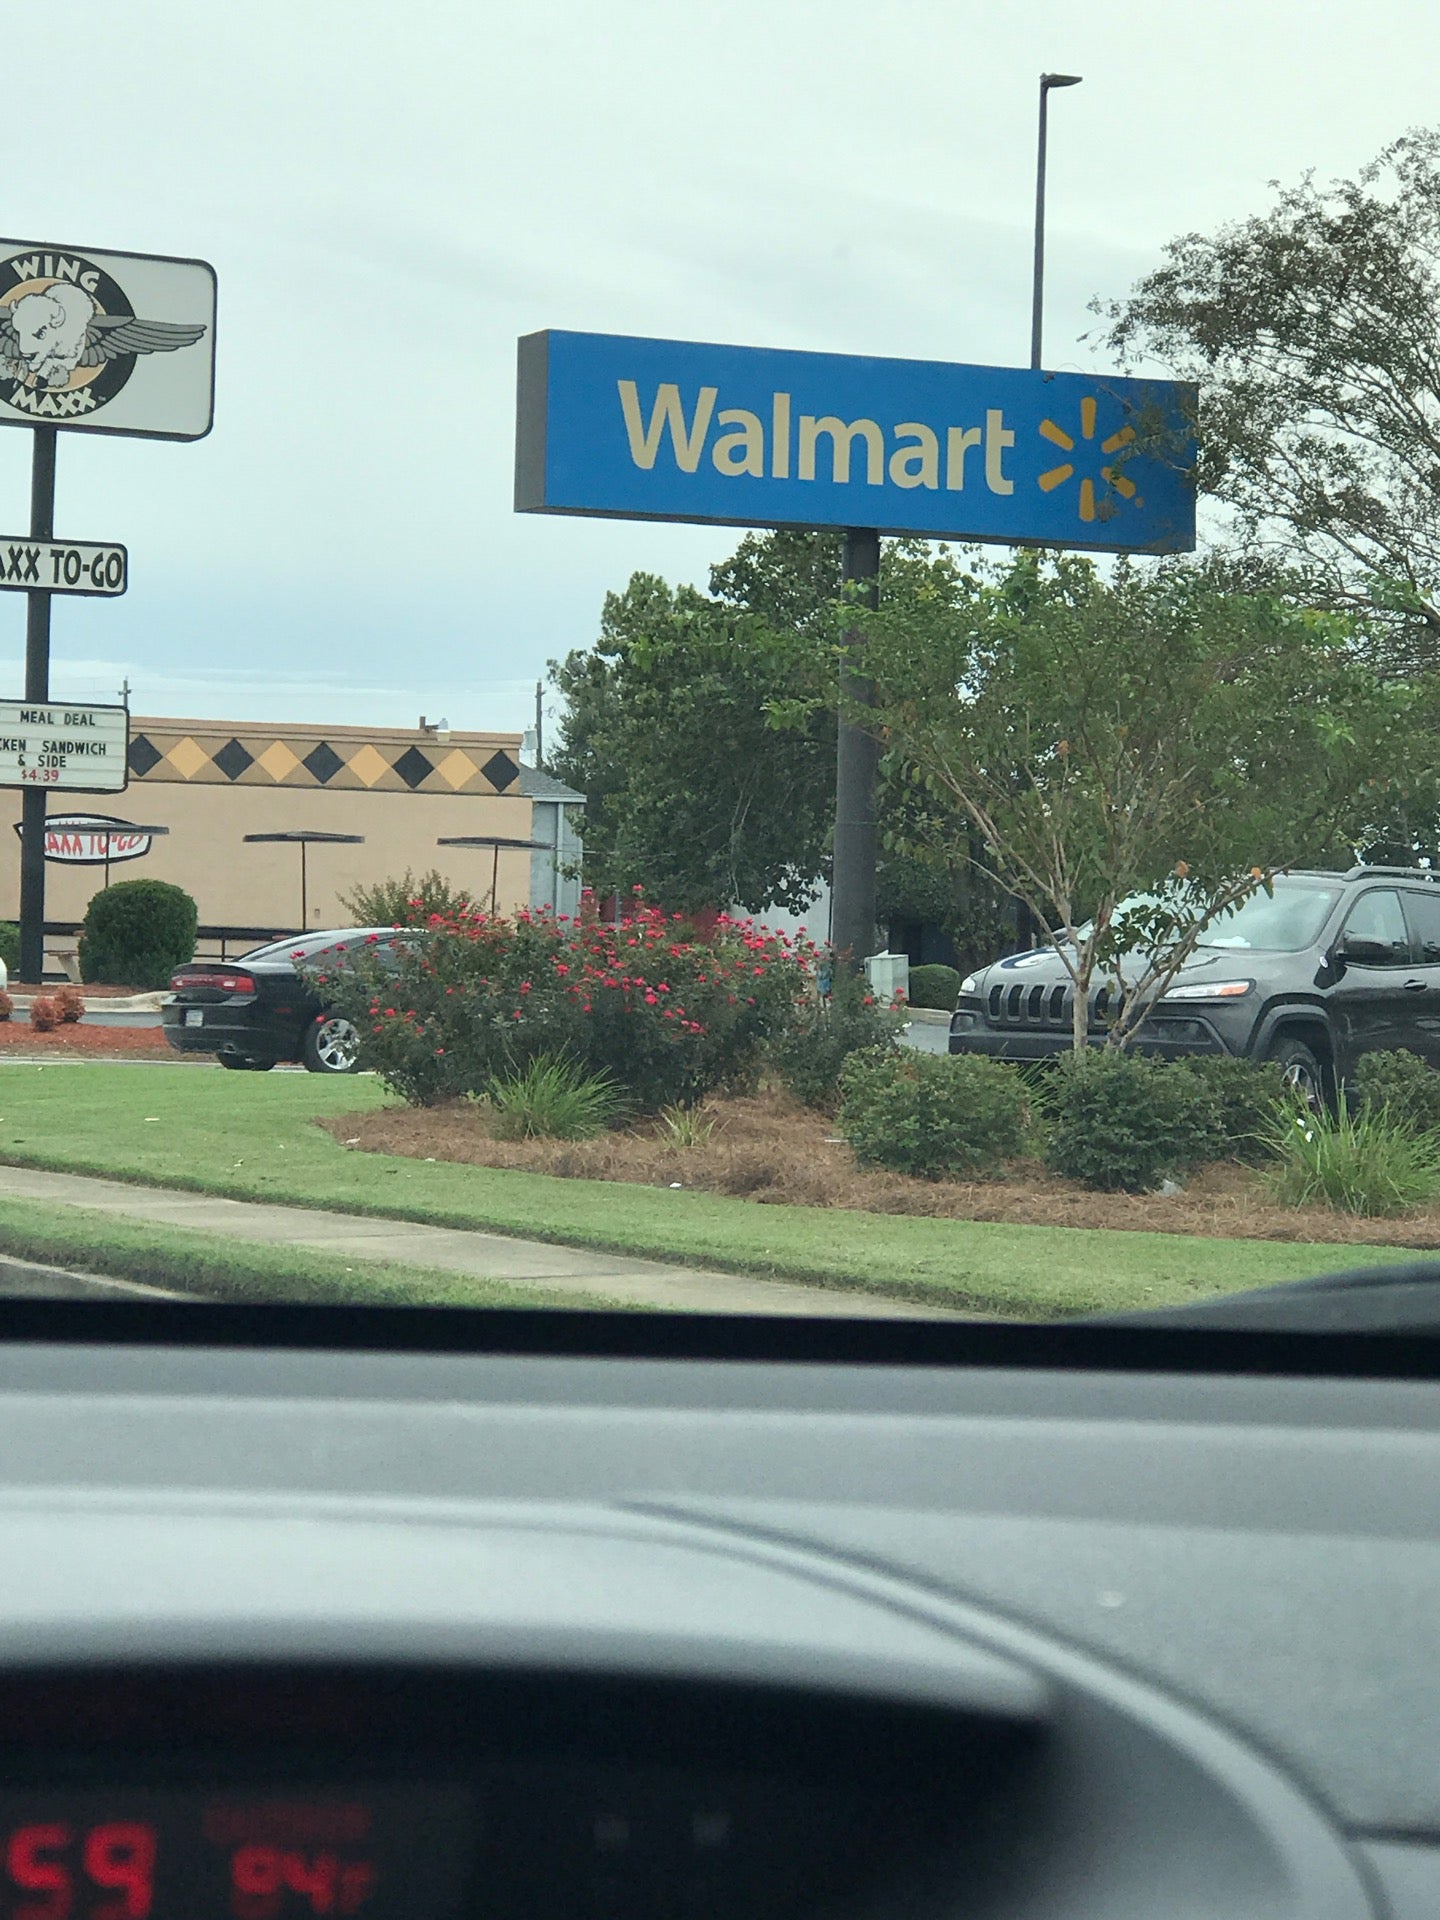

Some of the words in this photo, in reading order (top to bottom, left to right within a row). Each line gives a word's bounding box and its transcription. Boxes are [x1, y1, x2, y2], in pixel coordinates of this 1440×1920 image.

[10, 255, 100, 293] WING
[9, 386, 97, 416] MAXX
[617, 379, 1014, 495] Walmart
[0, 545, 41, 582] XX
[50, 549, 122, 588] TO-GO
[20, 710, 54, 725] MEAL
[64, 713, 96, 726] DEAL
[42, 740, 107, 755] SANDWICH
[17, 753, 26, 766] &
[38, 755, 67, 767] SIDE
[21, 769, 60, 782] $4.39
